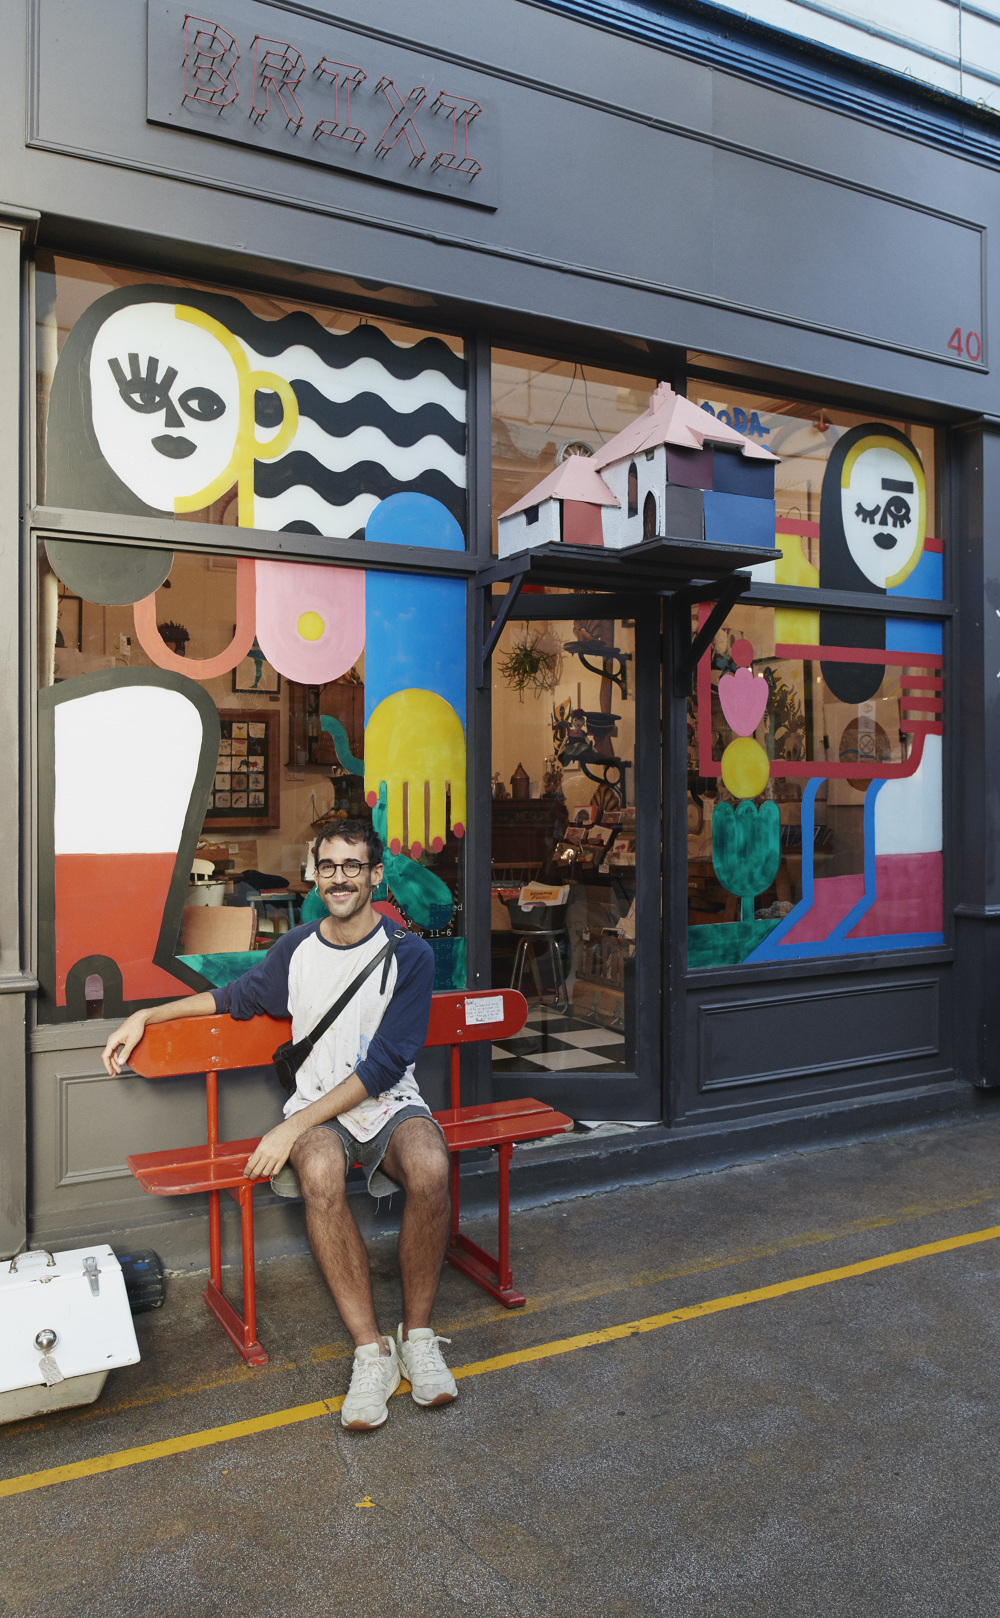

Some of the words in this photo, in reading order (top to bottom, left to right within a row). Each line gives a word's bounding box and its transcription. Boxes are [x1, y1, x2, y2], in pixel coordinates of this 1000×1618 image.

[181, 14, 482, 177] BRIXI
[947, 327, 982, 361] 40
[430, 928, 452, 937] 11-6
